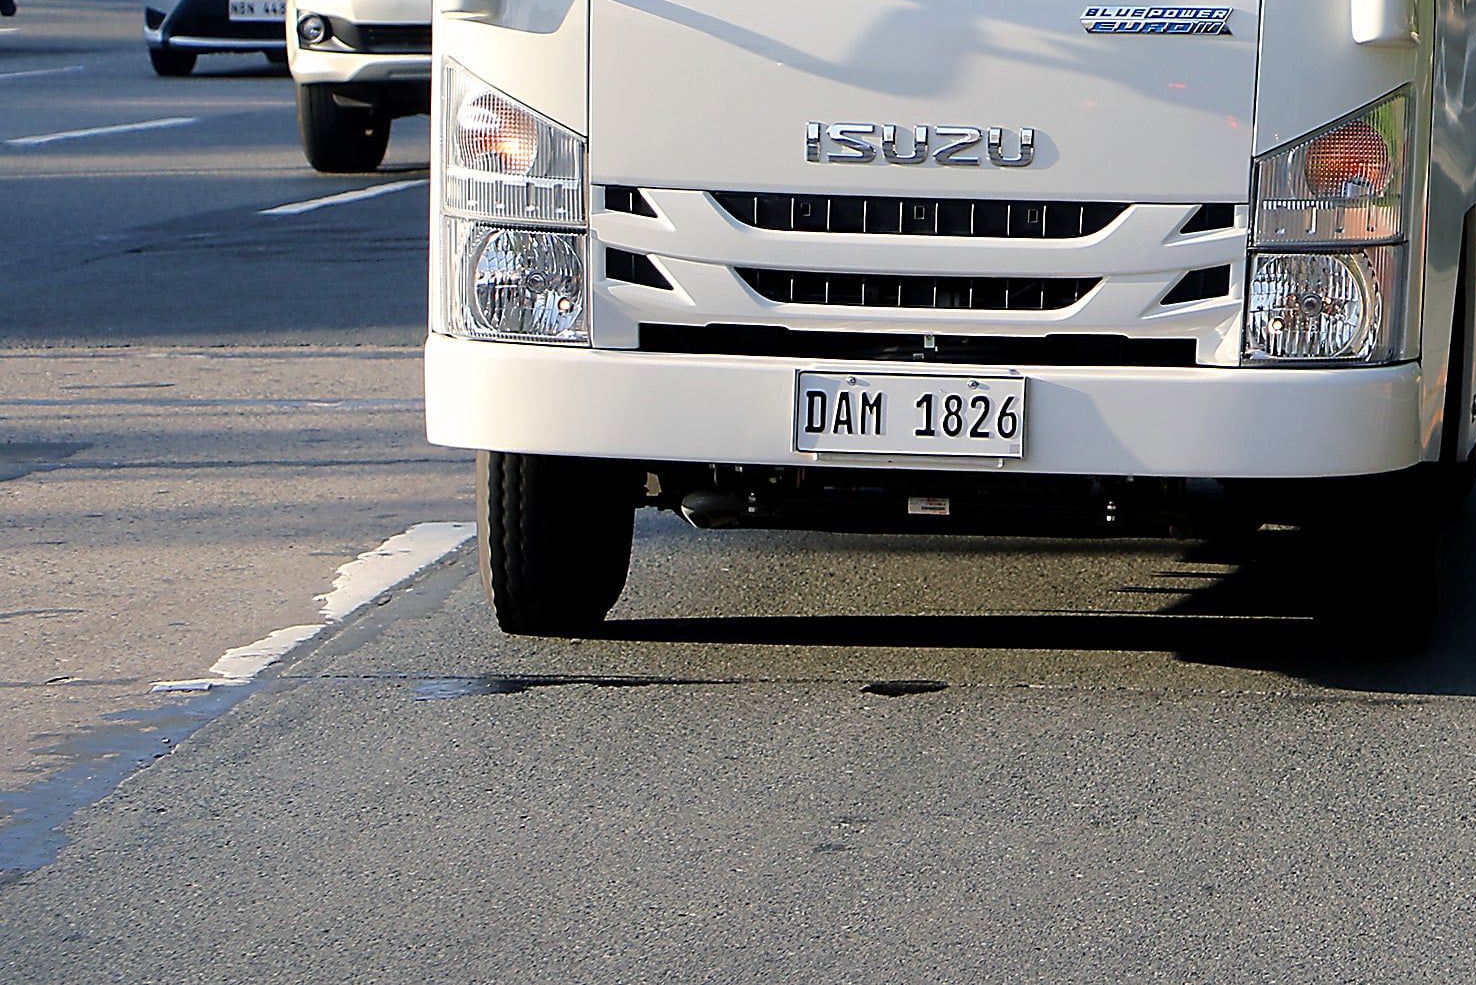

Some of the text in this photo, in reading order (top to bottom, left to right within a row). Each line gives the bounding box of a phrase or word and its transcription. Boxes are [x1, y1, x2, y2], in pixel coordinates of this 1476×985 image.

[1090, 21, 1193, 34] EURO
[805, 121, 1035, 168] ISUZU
[804, 389, 1018, 440] DAM 1826
